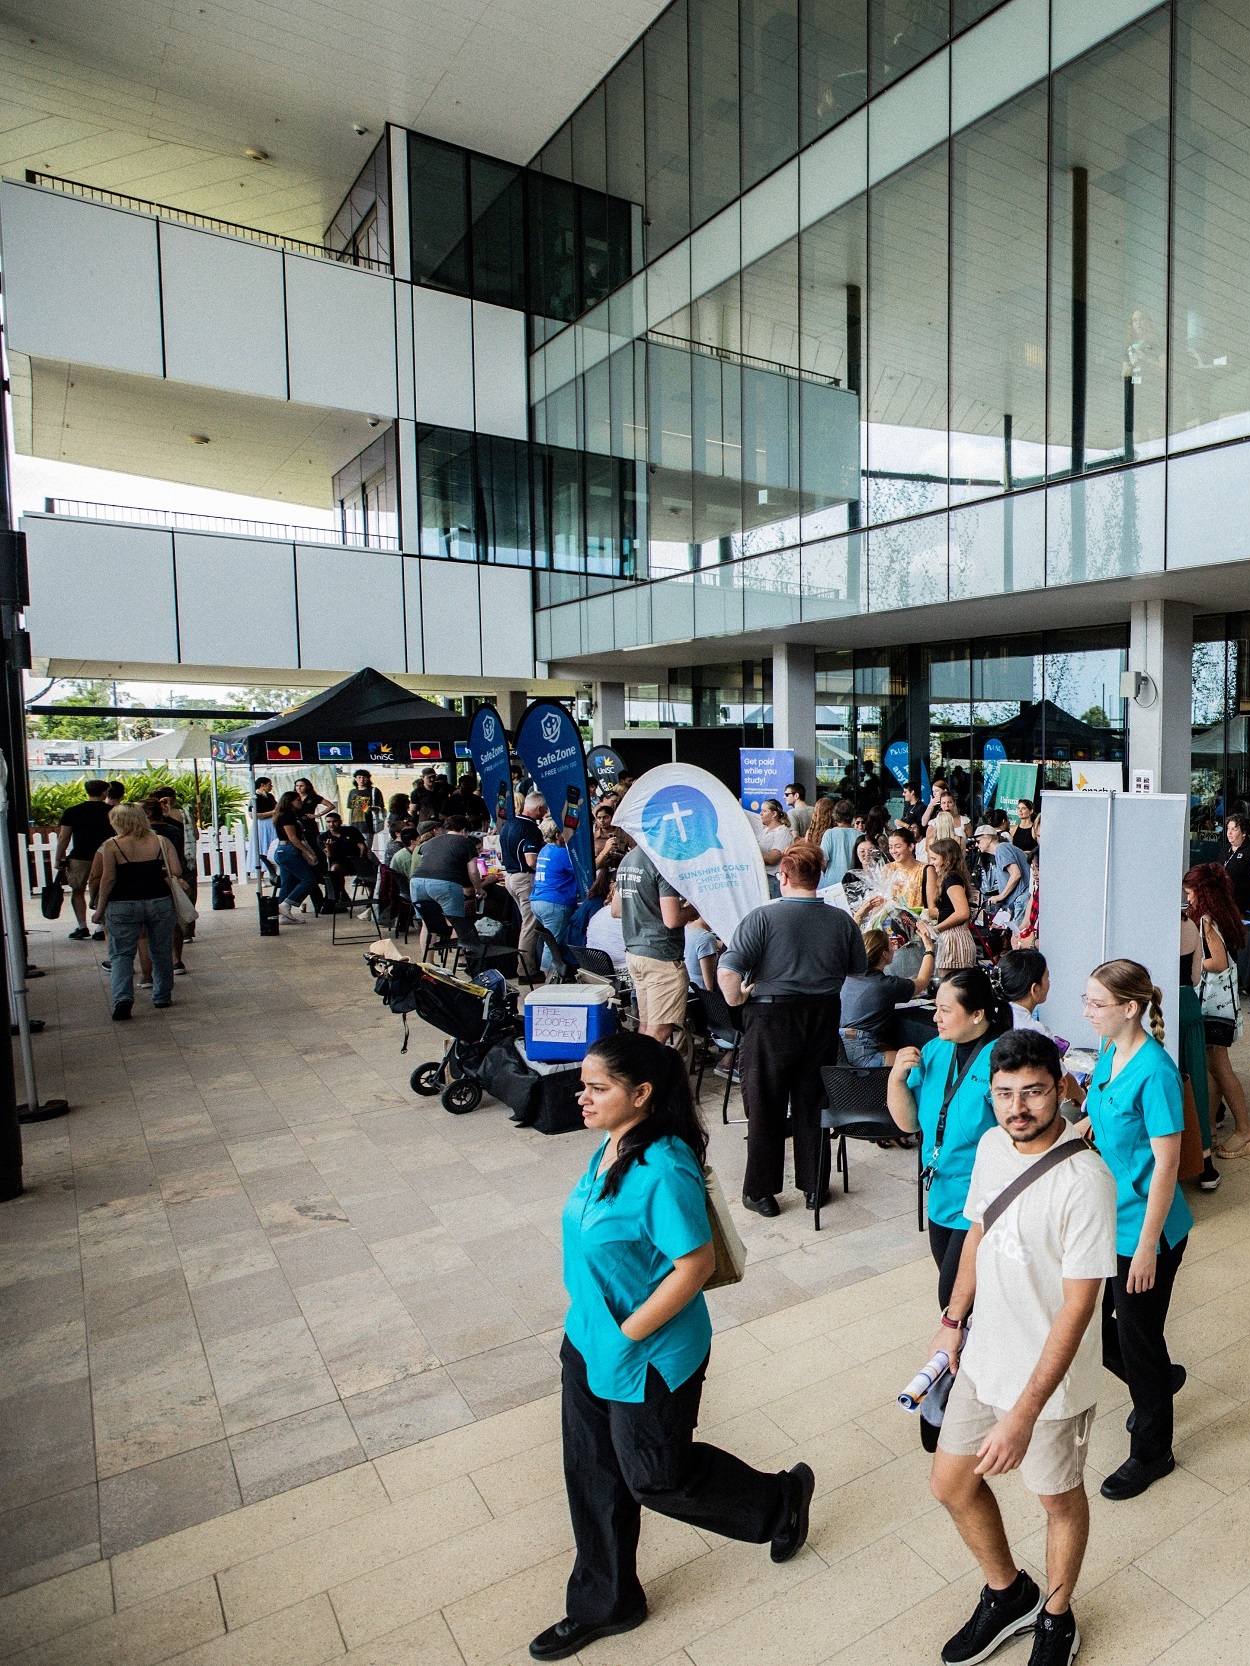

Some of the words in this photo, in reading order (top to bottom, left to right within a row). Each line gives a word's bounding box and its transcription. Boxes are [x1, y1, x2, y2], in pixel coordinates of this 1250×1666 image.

[369, 753, 394, 761] UniSC
[480, 744, 504, 765] SafeZone
[537, 745, 576, 768] SafeZone
[758, 757, 775, 767] paid
[544, 768, 557, 777] FREE
[744, 767, 763, 775] while
[764, 768, 777, 776] you
[744, 777, 766, 785] study!
[678, 866, 720, 881] SUNSHINE
[722, 864, 749, 872] COAST
[697, 880, 739, 893] STUDENTS
[537, 1007, 561, 1017] FREE
[535, 1018, 578, 1029] ZOOPER
